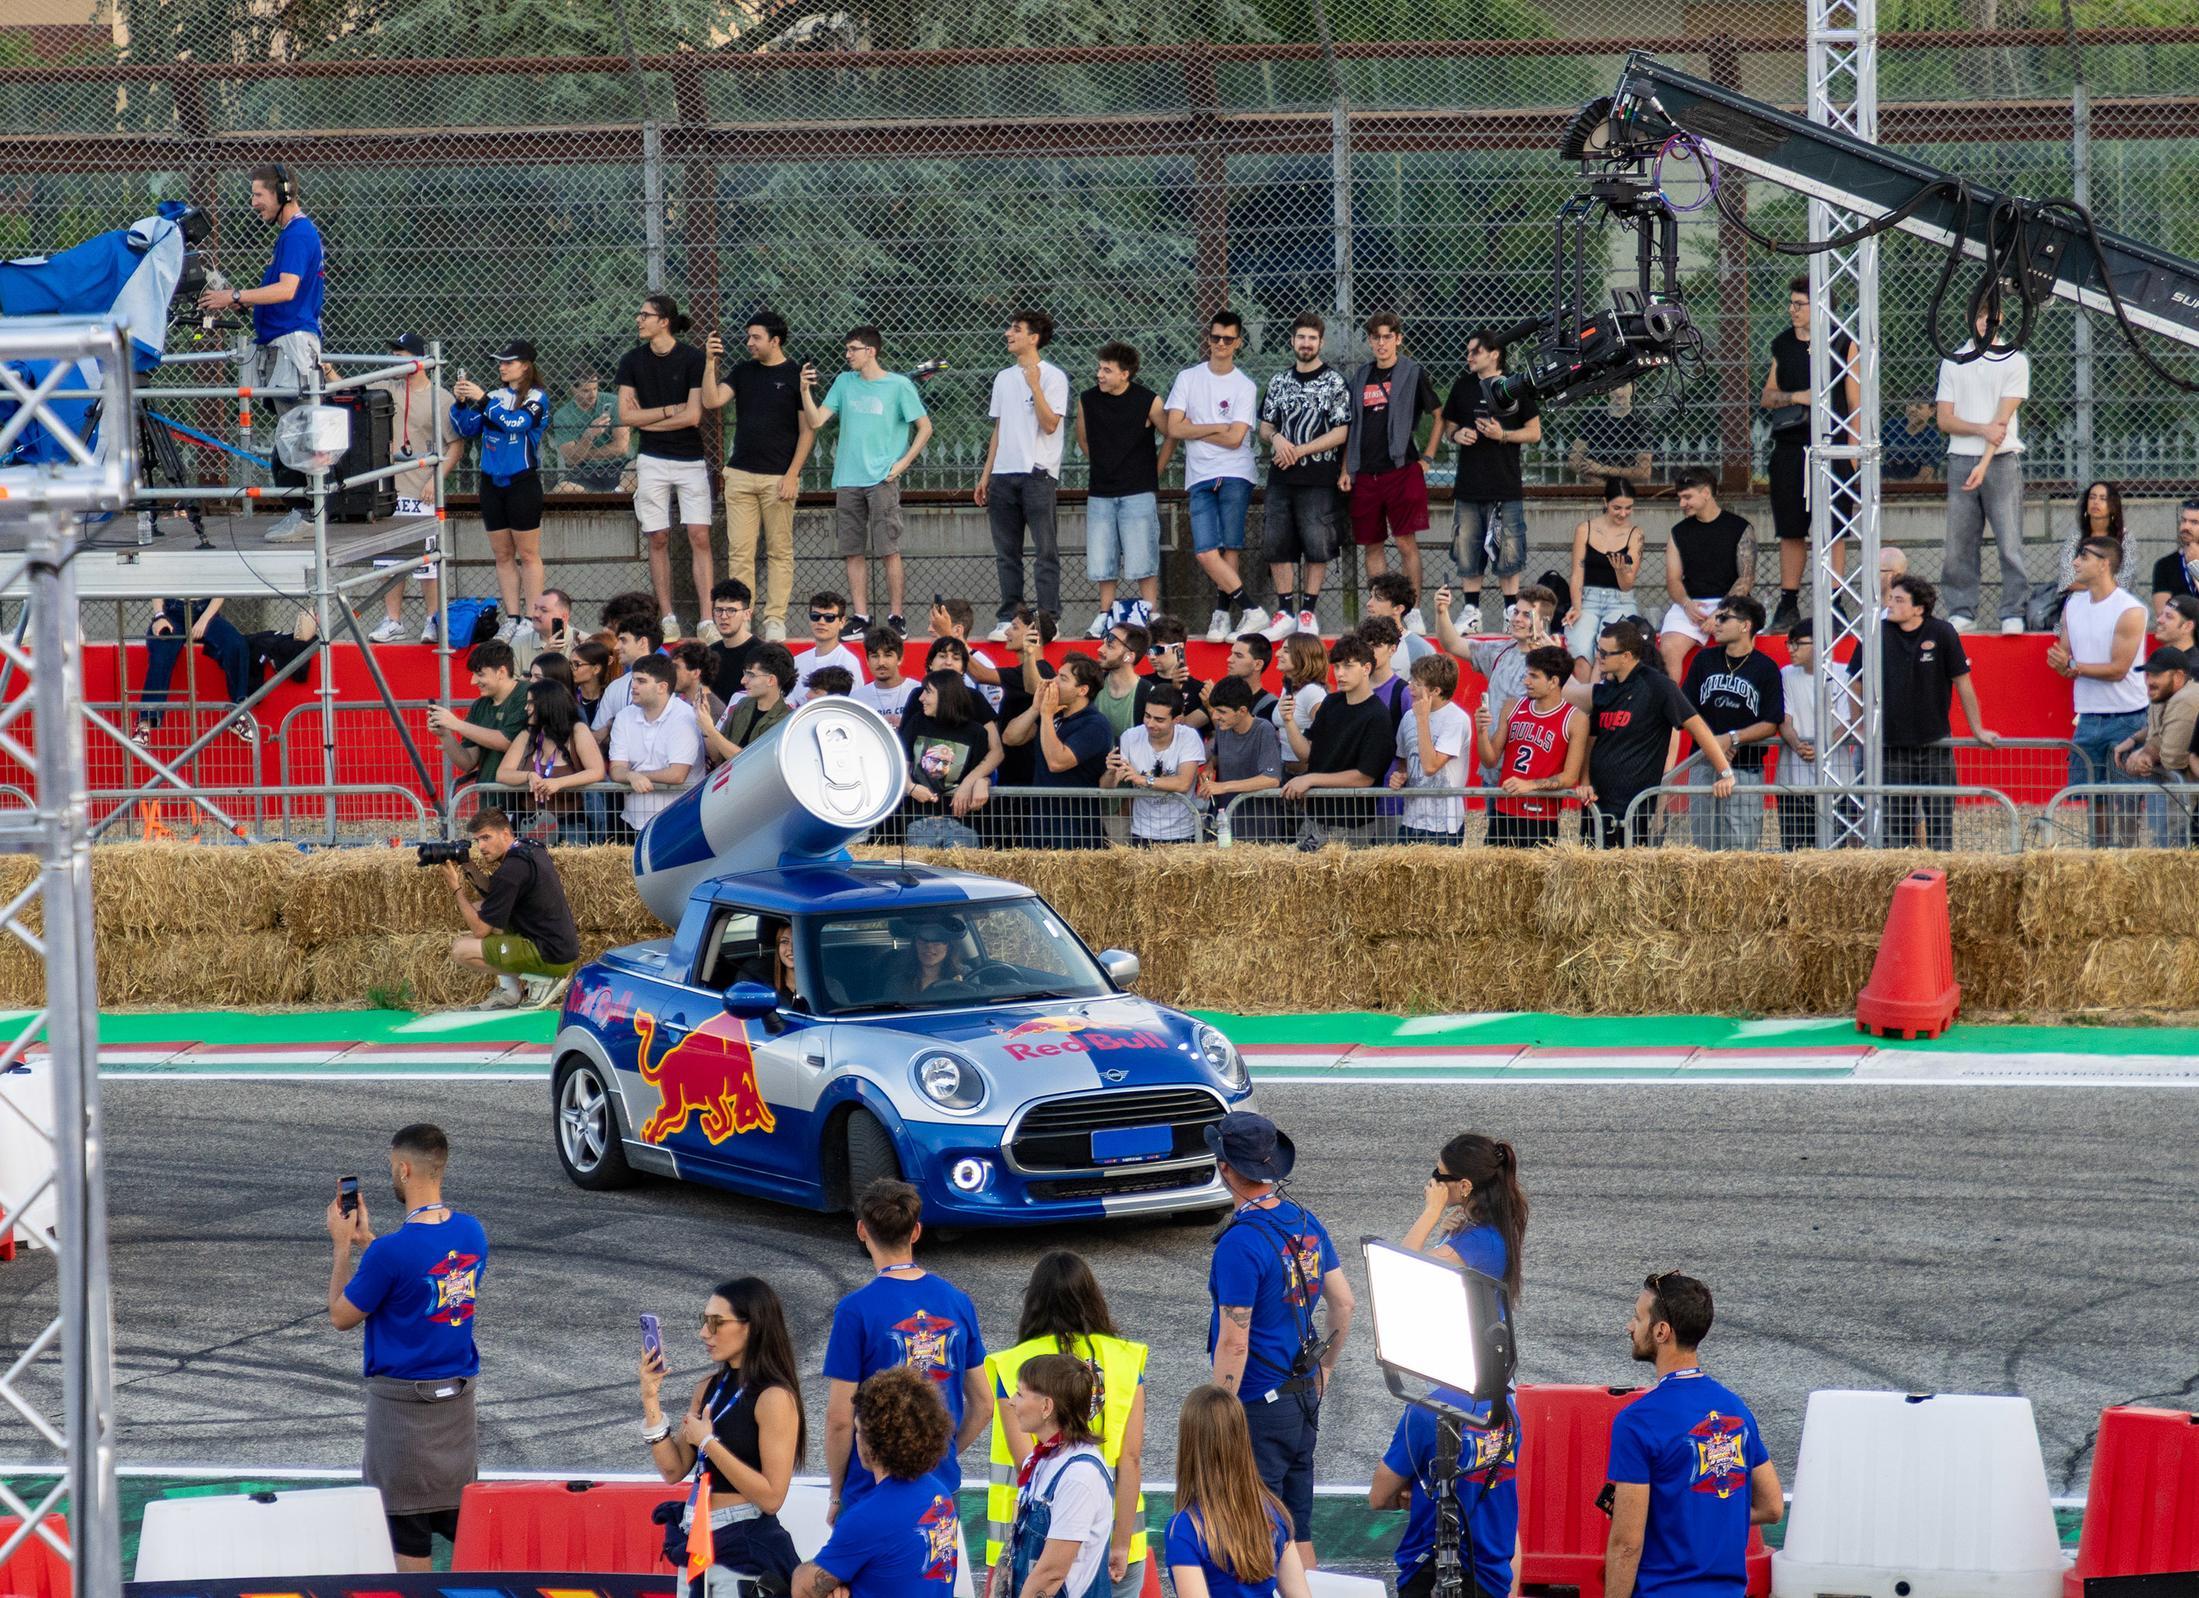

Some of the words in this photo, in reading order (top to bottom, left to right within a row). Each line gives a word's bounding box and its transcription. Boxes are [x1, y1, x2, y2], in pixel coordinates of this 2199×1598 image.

[1700, 673, 1759, 717] MILLION
[1508, 720, 1555, 753] BULLS
[1512, 744, 1535, 775] 2
[1002, 1033, 1090, 1062] Red
[1083, 1031, 1168, 1050] Bull
